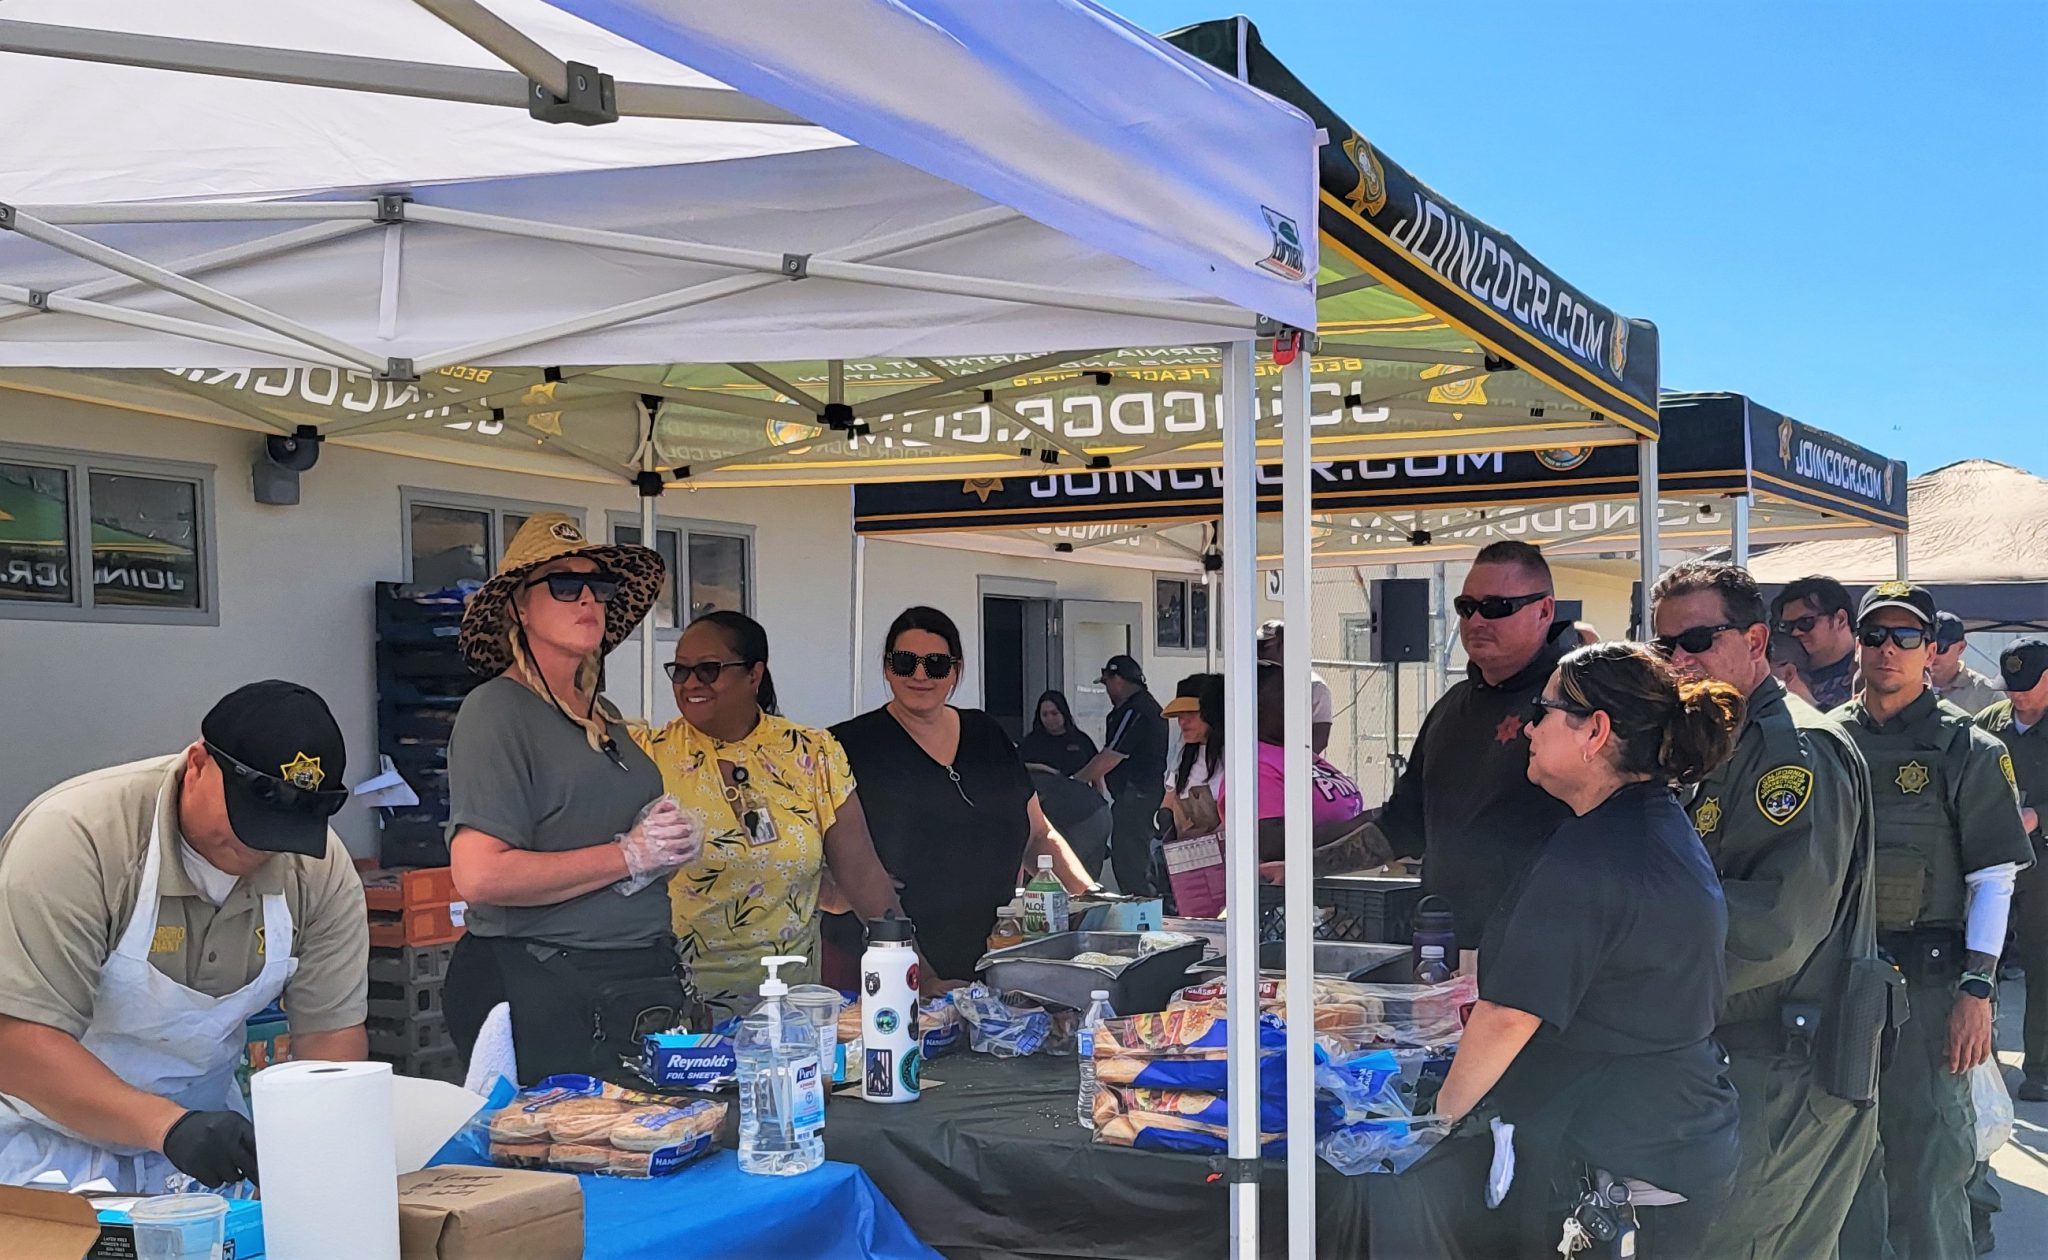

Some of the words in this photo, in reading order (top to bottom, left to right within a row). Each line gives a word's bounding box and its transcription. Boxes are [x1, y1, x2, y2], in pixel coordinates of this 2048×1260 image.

[1389, 192, 1603, 369] JOINCDCR.COM
[1796, 439, 1882, 501] JOINCDCR.COM
[1025, 902, 1046, 911] ALOE
[667, 1054, 730, 1070] Reynolds
[666, 1072, 684, 1080] FOIL
